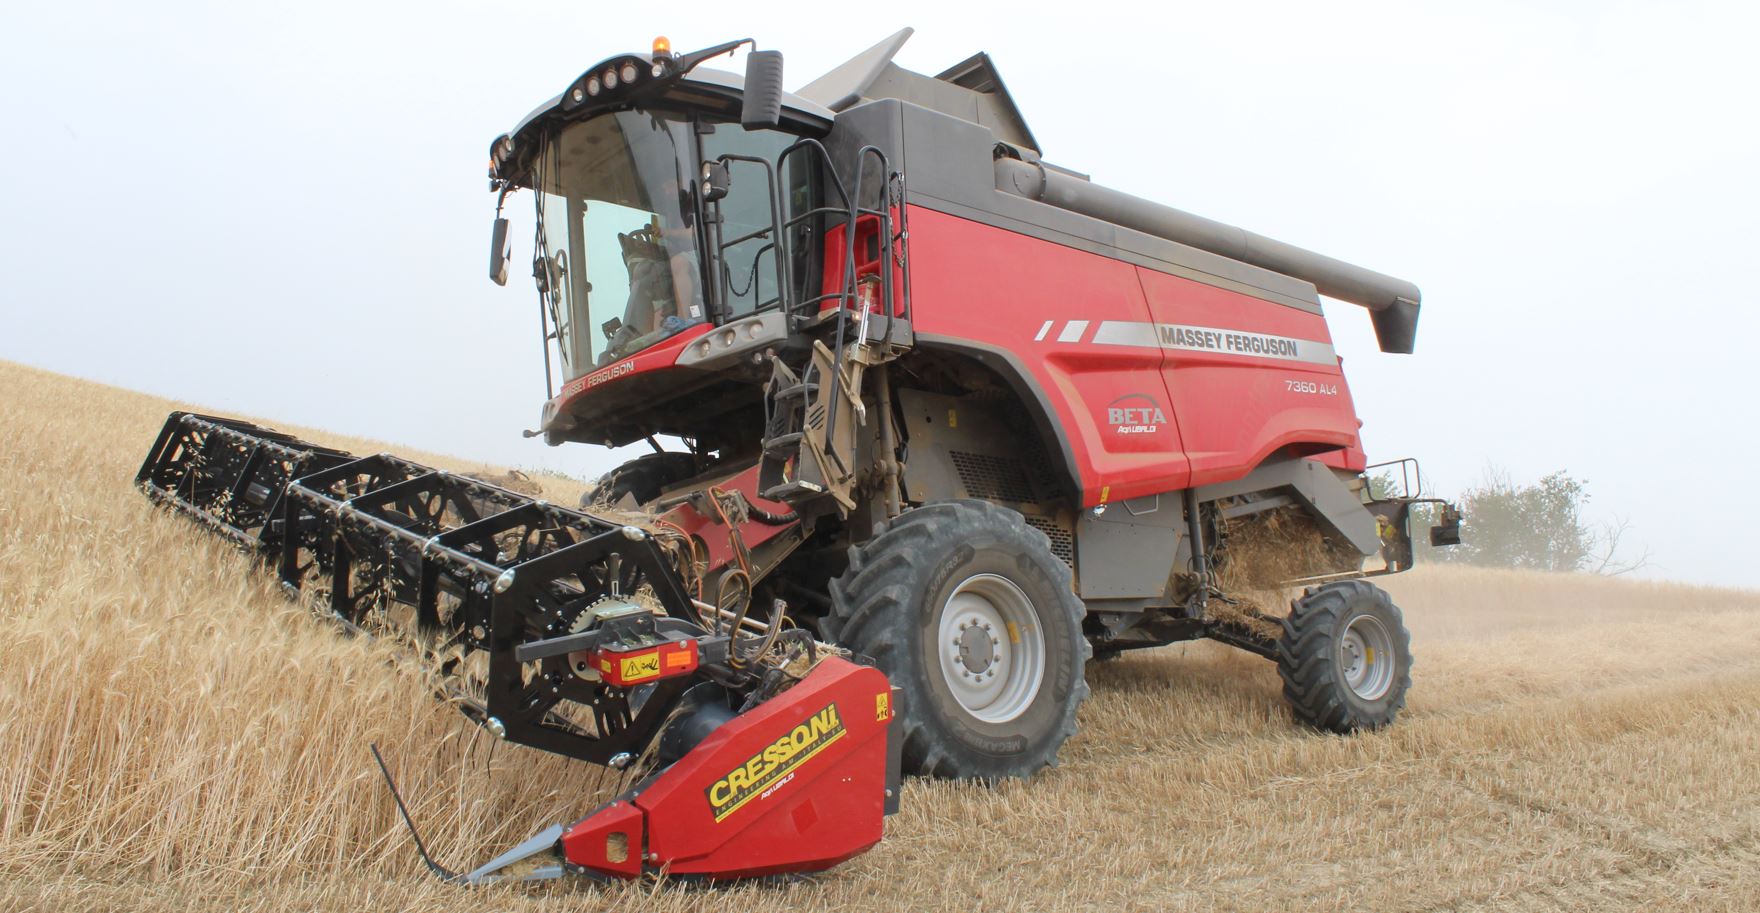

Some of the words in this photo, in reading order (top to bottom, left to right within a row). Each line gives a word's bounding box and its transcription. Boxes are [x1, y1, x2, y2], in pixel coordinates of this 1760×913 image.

[1160, 326, 1223, 350] MASSEY
[1225, 333, 1298, 357] FERGUSON
[588, 361, 634, 388] FERGUSON
[1285, 379, 1317, 394] 7360
[1319, 383, 1338, 395] AL4
[1107, 407, 1168, 425] BETA
